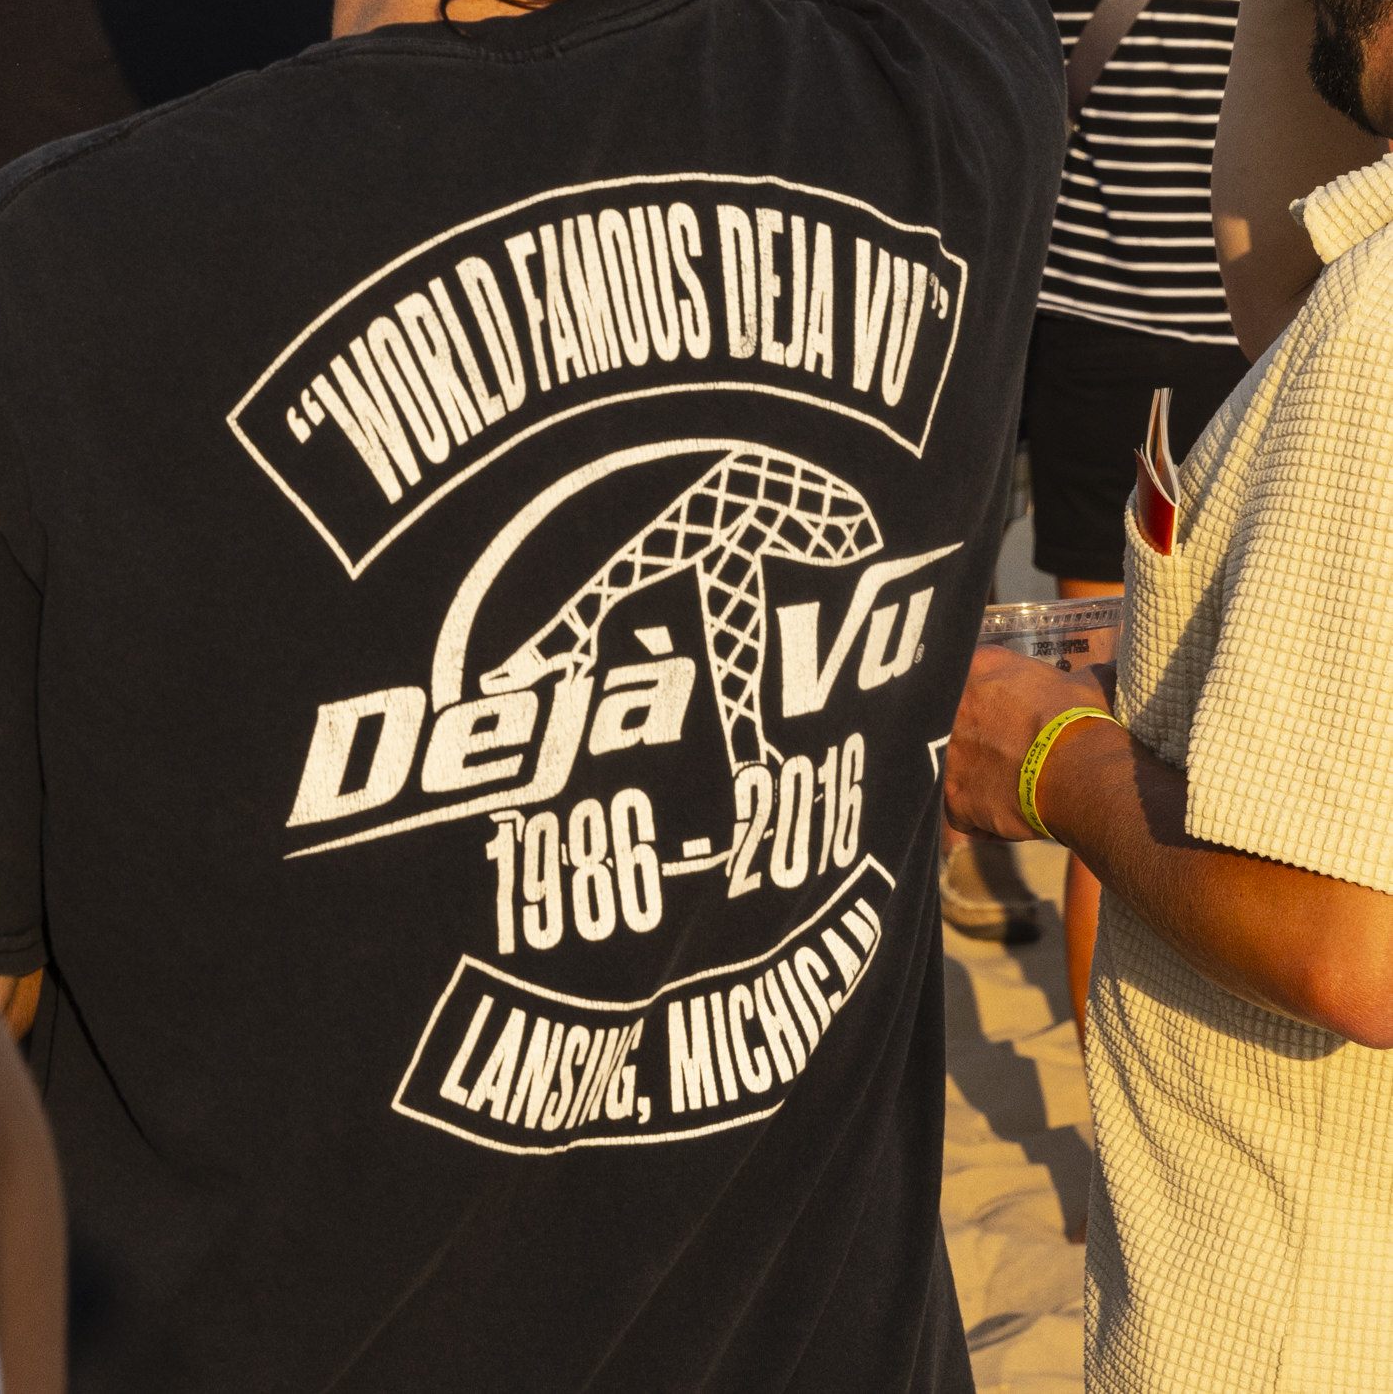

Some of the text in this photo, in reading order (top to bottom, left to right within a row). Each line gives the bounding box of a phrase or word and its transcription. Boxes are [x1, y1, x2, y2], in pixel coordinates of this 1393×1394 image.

[504, 202, 711, 392] FAMOUS
[717, 204, 834, 379] DEJA
[439, 897, 881, 1132] LANSING, MICHIGAN
